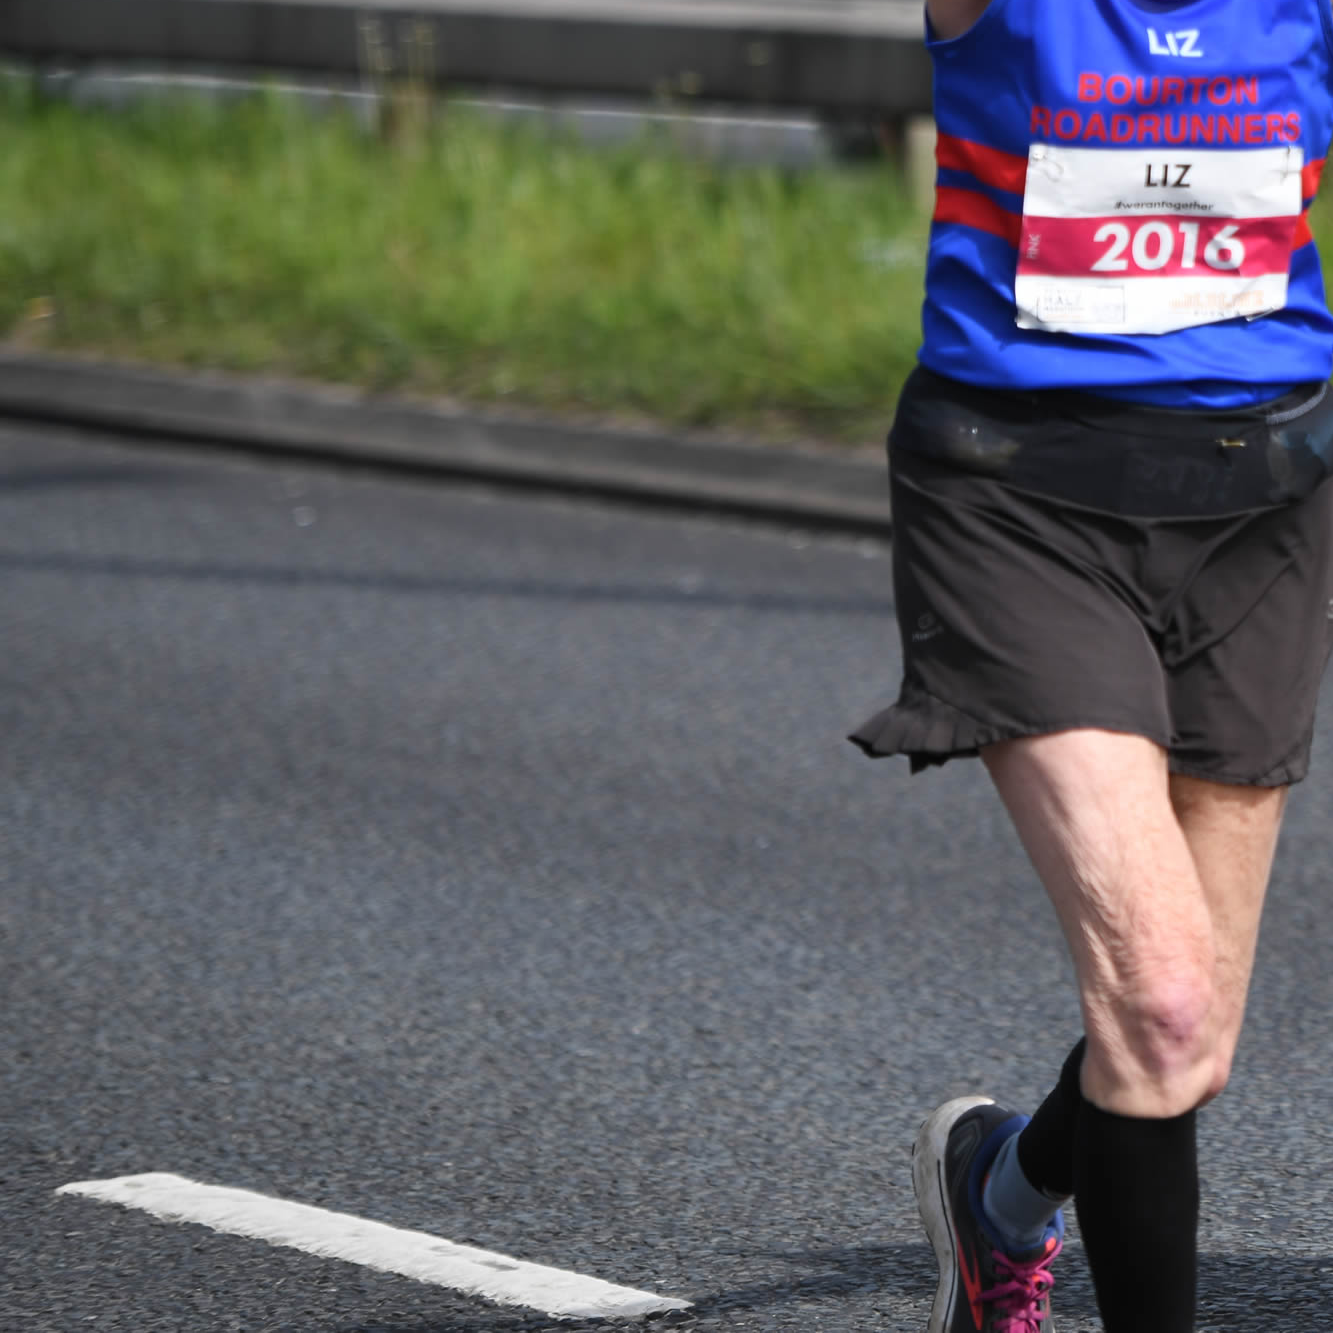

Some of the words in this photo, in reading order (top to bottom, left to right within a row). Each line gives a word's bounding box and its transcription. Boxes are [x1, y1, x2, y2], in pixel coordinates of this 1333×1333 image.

[1148, 28, 1203, 58] LIZ
[1078, 72, 1258, 106] BOURTON
[1030, 106, 1300, 144] ROADRUNNERS
[1145, 164, 1192, 188] LIZ
[1113, 200, 1215, 211] #werantogether
[1090, 221, 1245, 271] 2016
